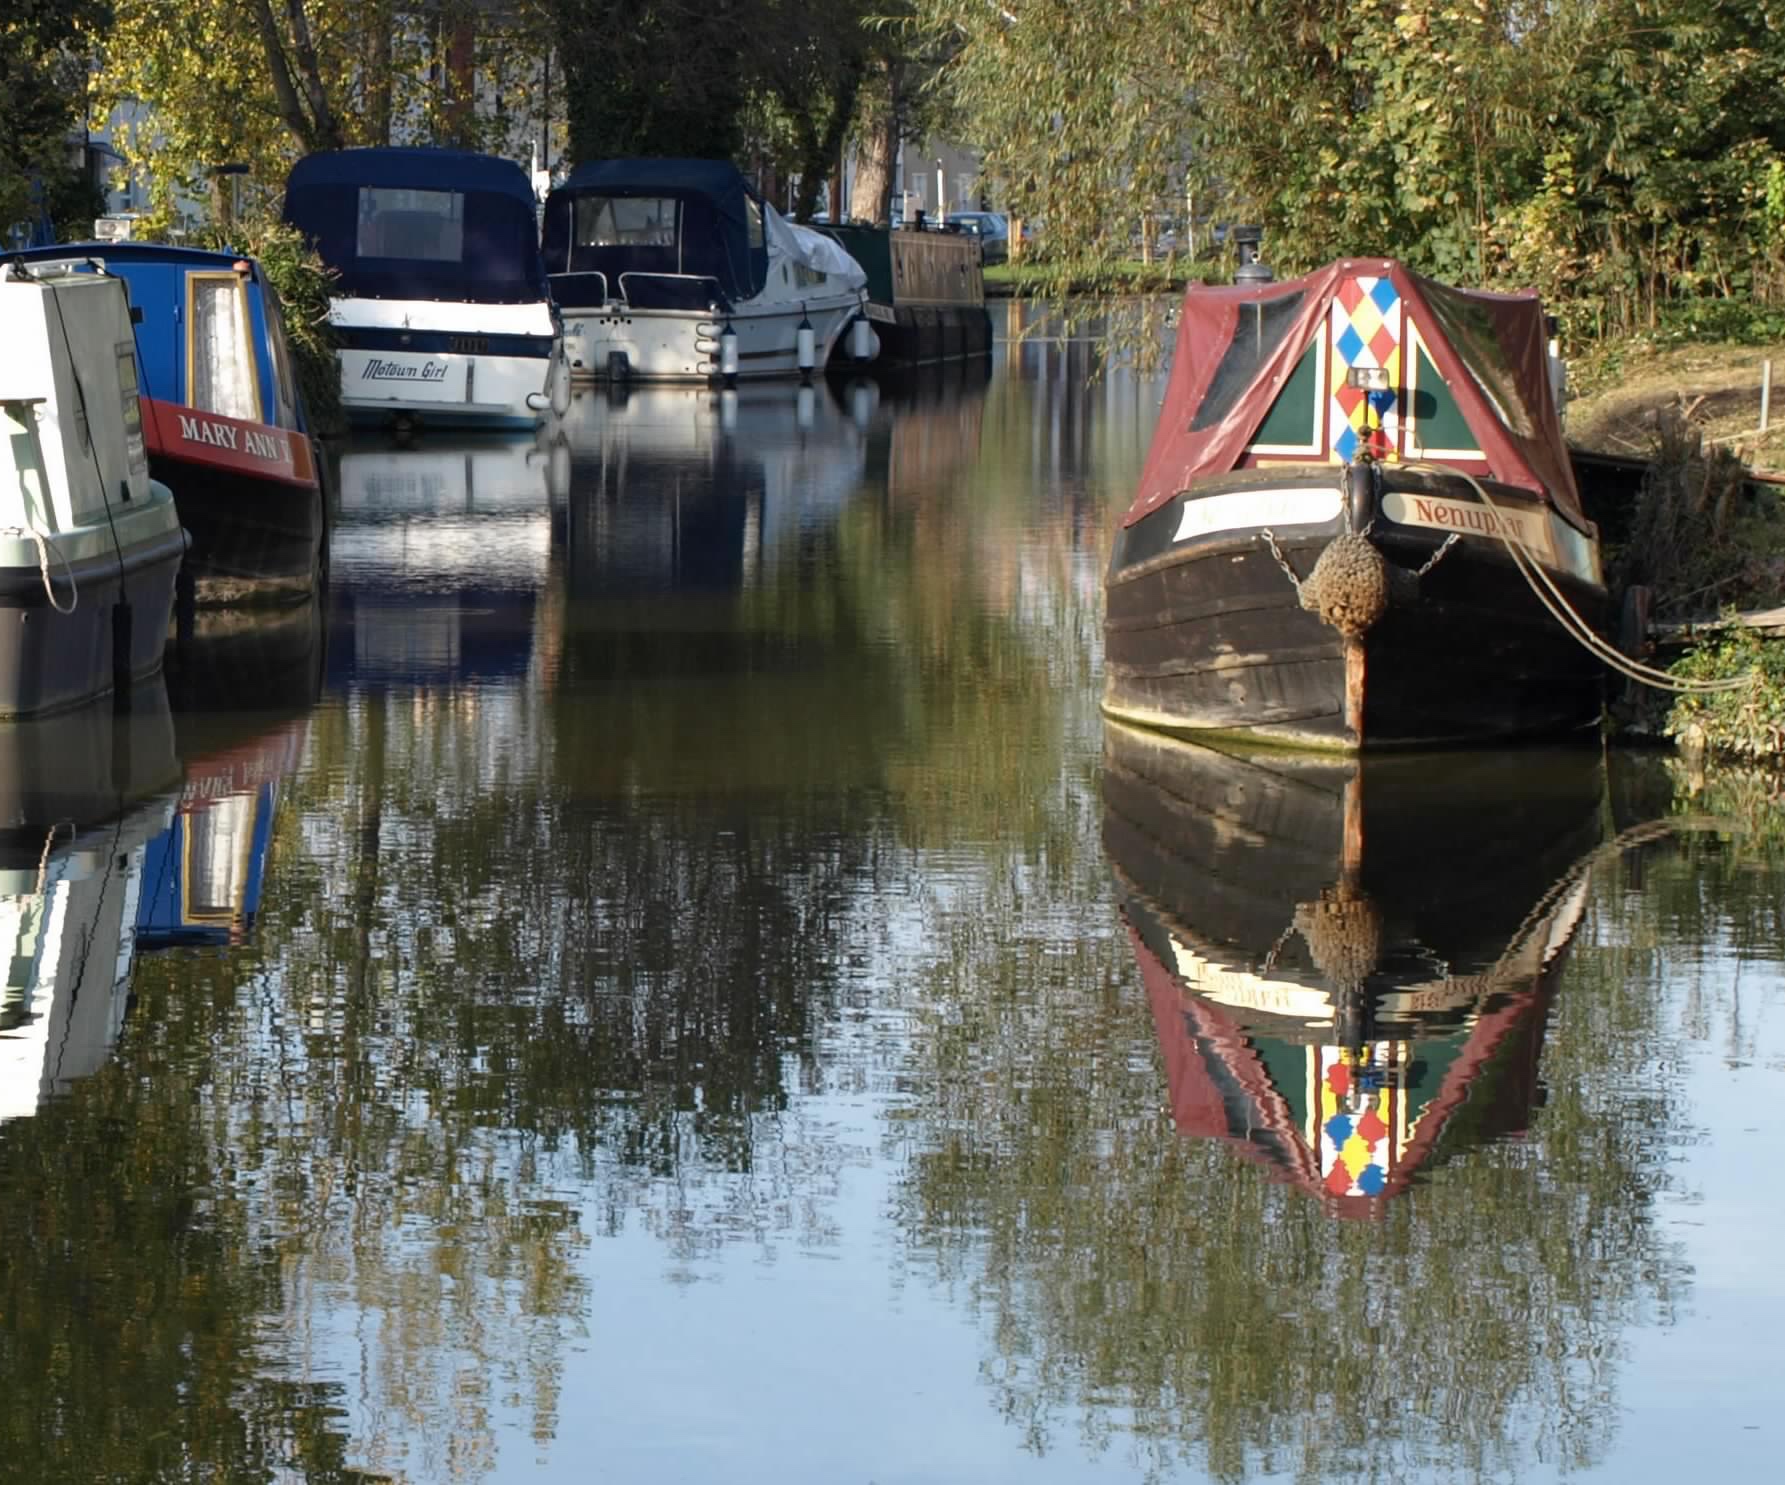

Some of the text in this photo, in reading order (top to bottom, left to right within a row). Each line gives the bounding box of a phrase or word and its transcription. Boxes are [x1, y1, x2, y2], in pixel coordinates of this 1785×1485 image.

[421, 361, 449, 378] Girl
[178, 415, 238, 450] MARY
[245, 430, 278, 460] ANN
